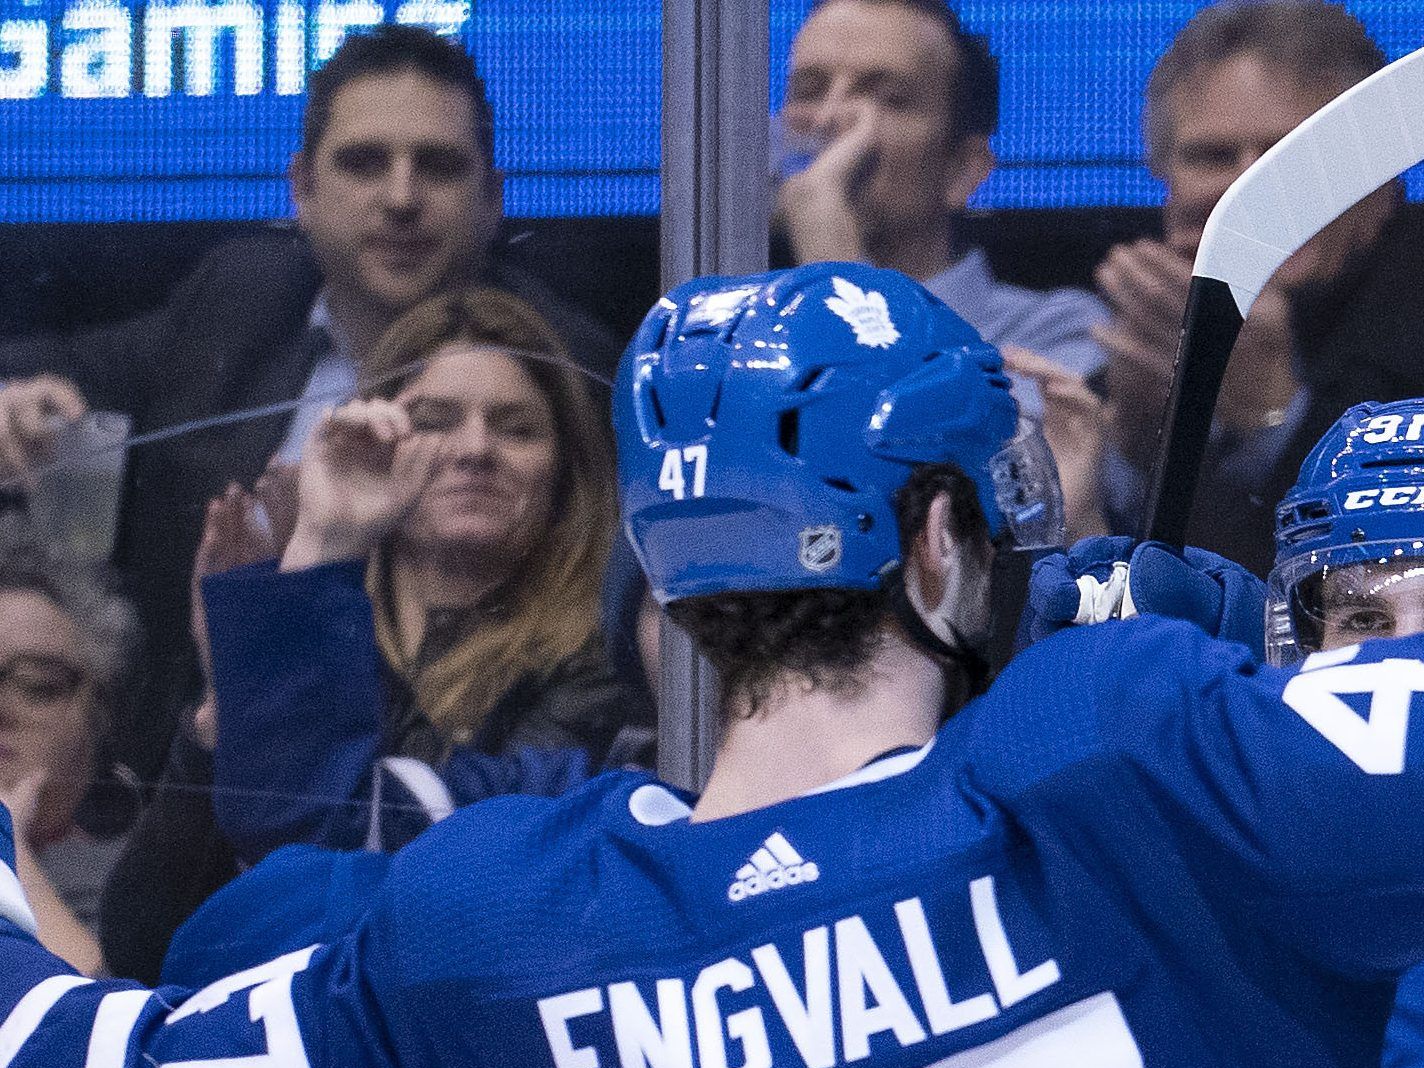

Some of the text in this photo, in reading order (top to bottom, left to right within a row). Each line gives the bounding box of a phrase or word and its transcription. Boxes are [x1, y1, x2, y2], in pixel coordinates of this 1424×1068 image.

[0, 0, 470, 98] ami
[658, 444, 708, 500] 47
[728, 861, 820, 902] adidas
